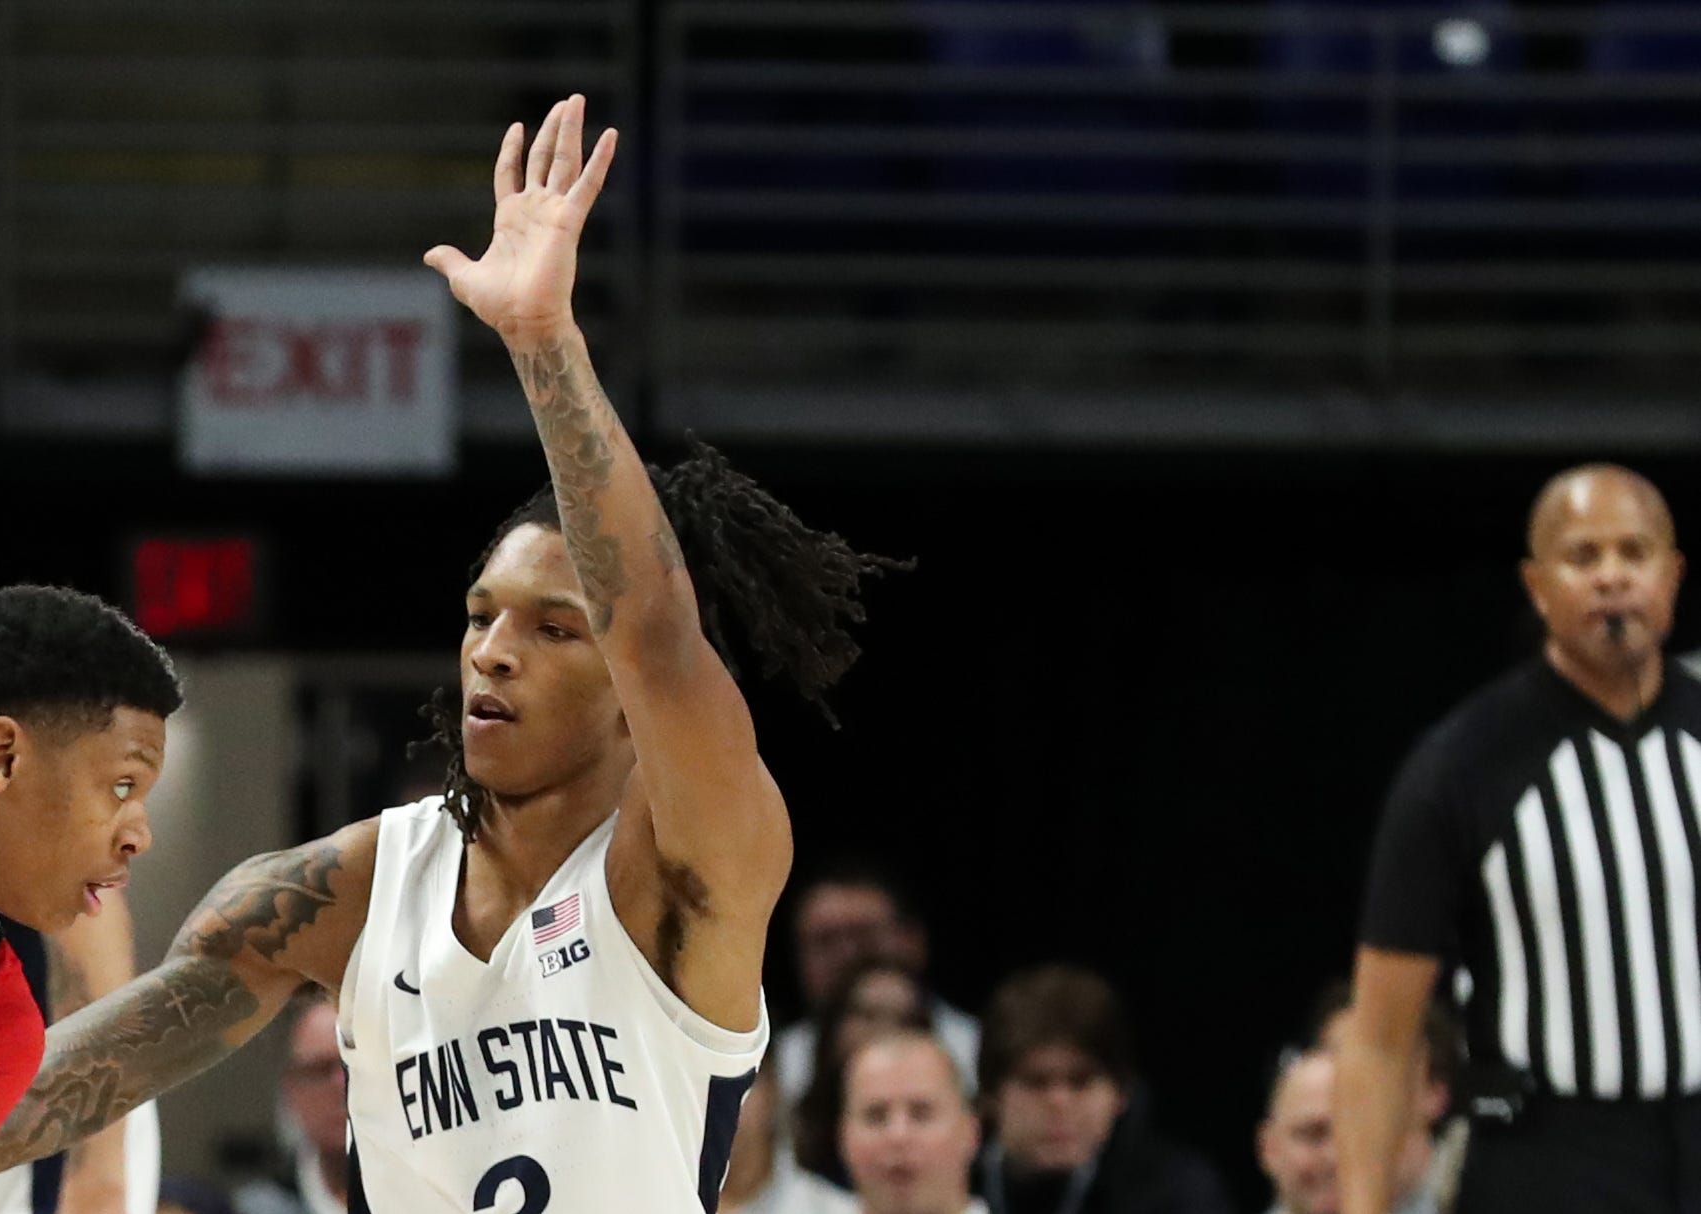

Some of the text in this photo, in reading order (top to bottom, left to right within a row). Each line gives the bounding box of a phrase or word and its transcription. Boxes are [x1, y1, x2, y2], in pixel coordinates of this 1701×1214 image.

[202, 316, 424, 408] EXIT
[395, 1018, 638, 1140] ENN STATE
